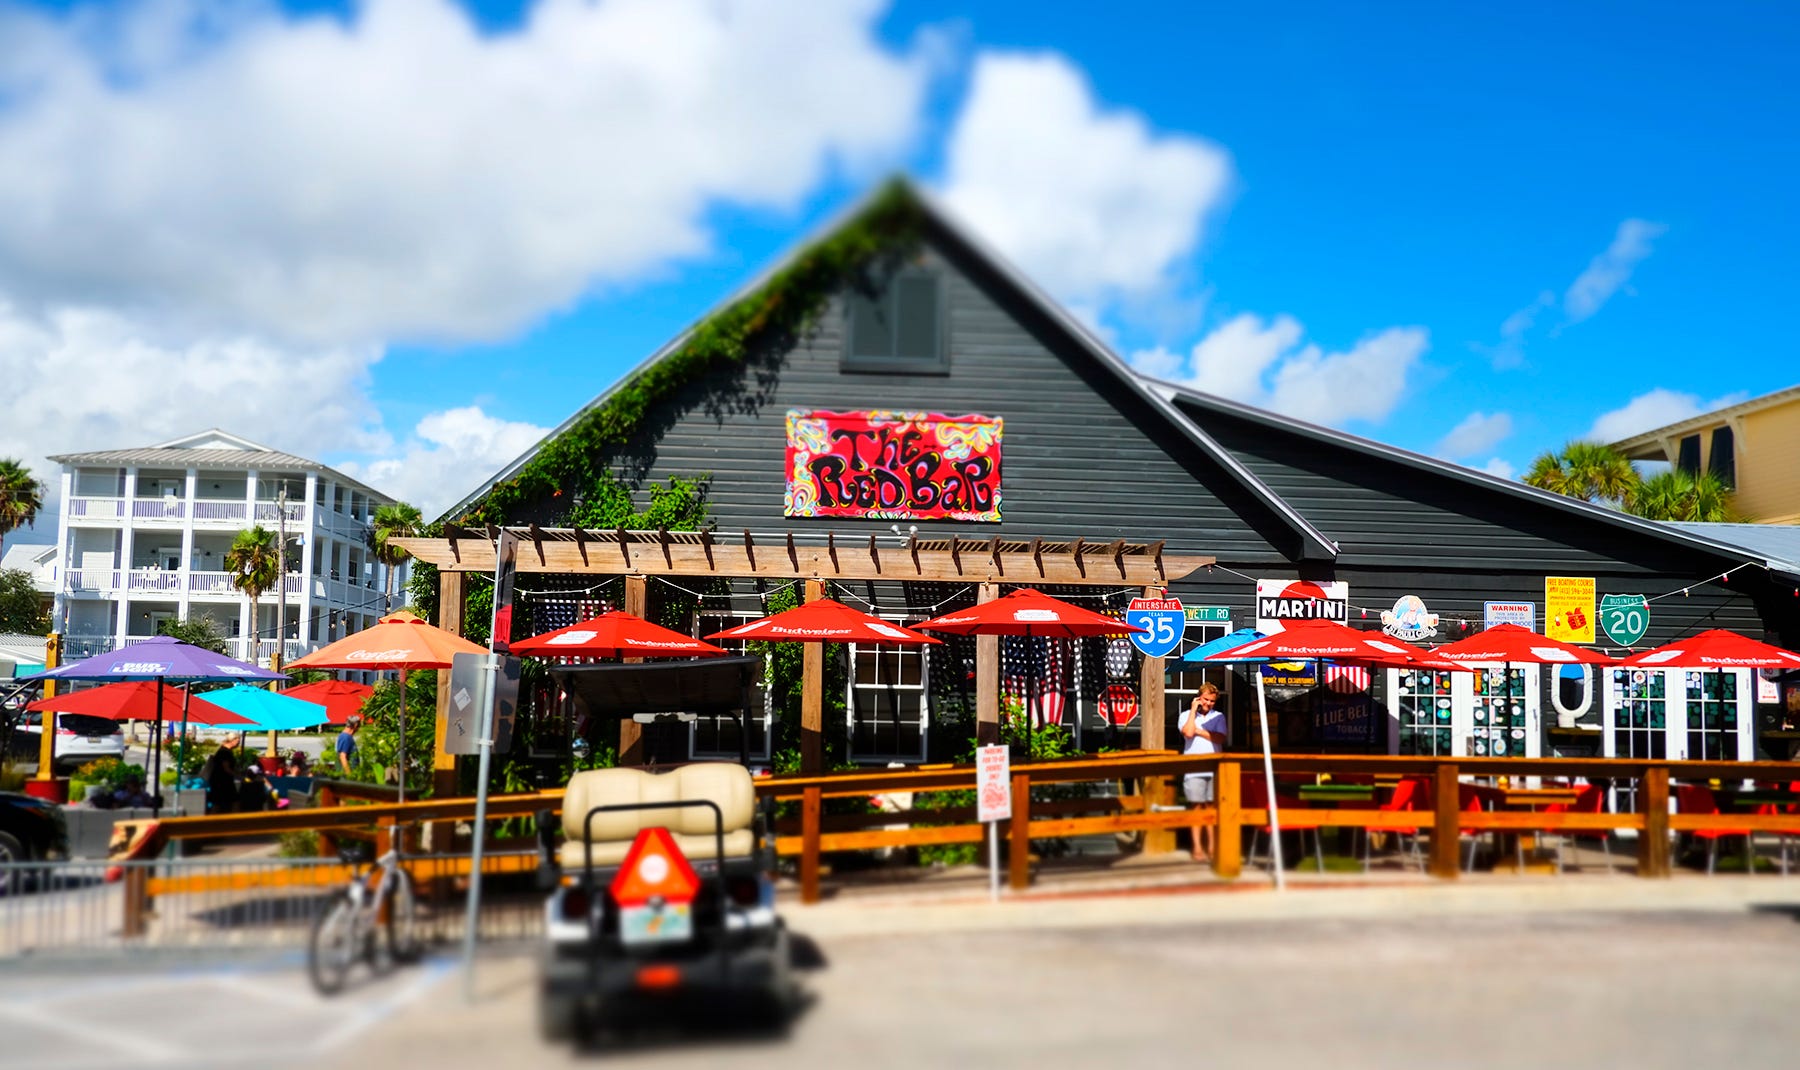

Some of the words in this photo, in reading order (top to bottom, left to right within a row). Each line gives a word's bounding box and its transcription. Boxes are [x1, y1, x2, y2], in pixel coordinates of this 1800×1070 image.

[1134, 601, 1177, 610] INTERSTATE
[1261, 599, 1343, 619] MARTINI
[1216, 608, 1229, 619] RD
[1610, 610, 1642, 635] 20
[771, 626, 852, 636] Budweiser
[1138, 616, 1175, 644] 35
[1276, 646, 1356, 655] Budweiser
[1701, 657, 1783, 665] Budweiser
[1102, 697, 1135, 713] STOP
[1347, 704, 1374, 720] BEL
